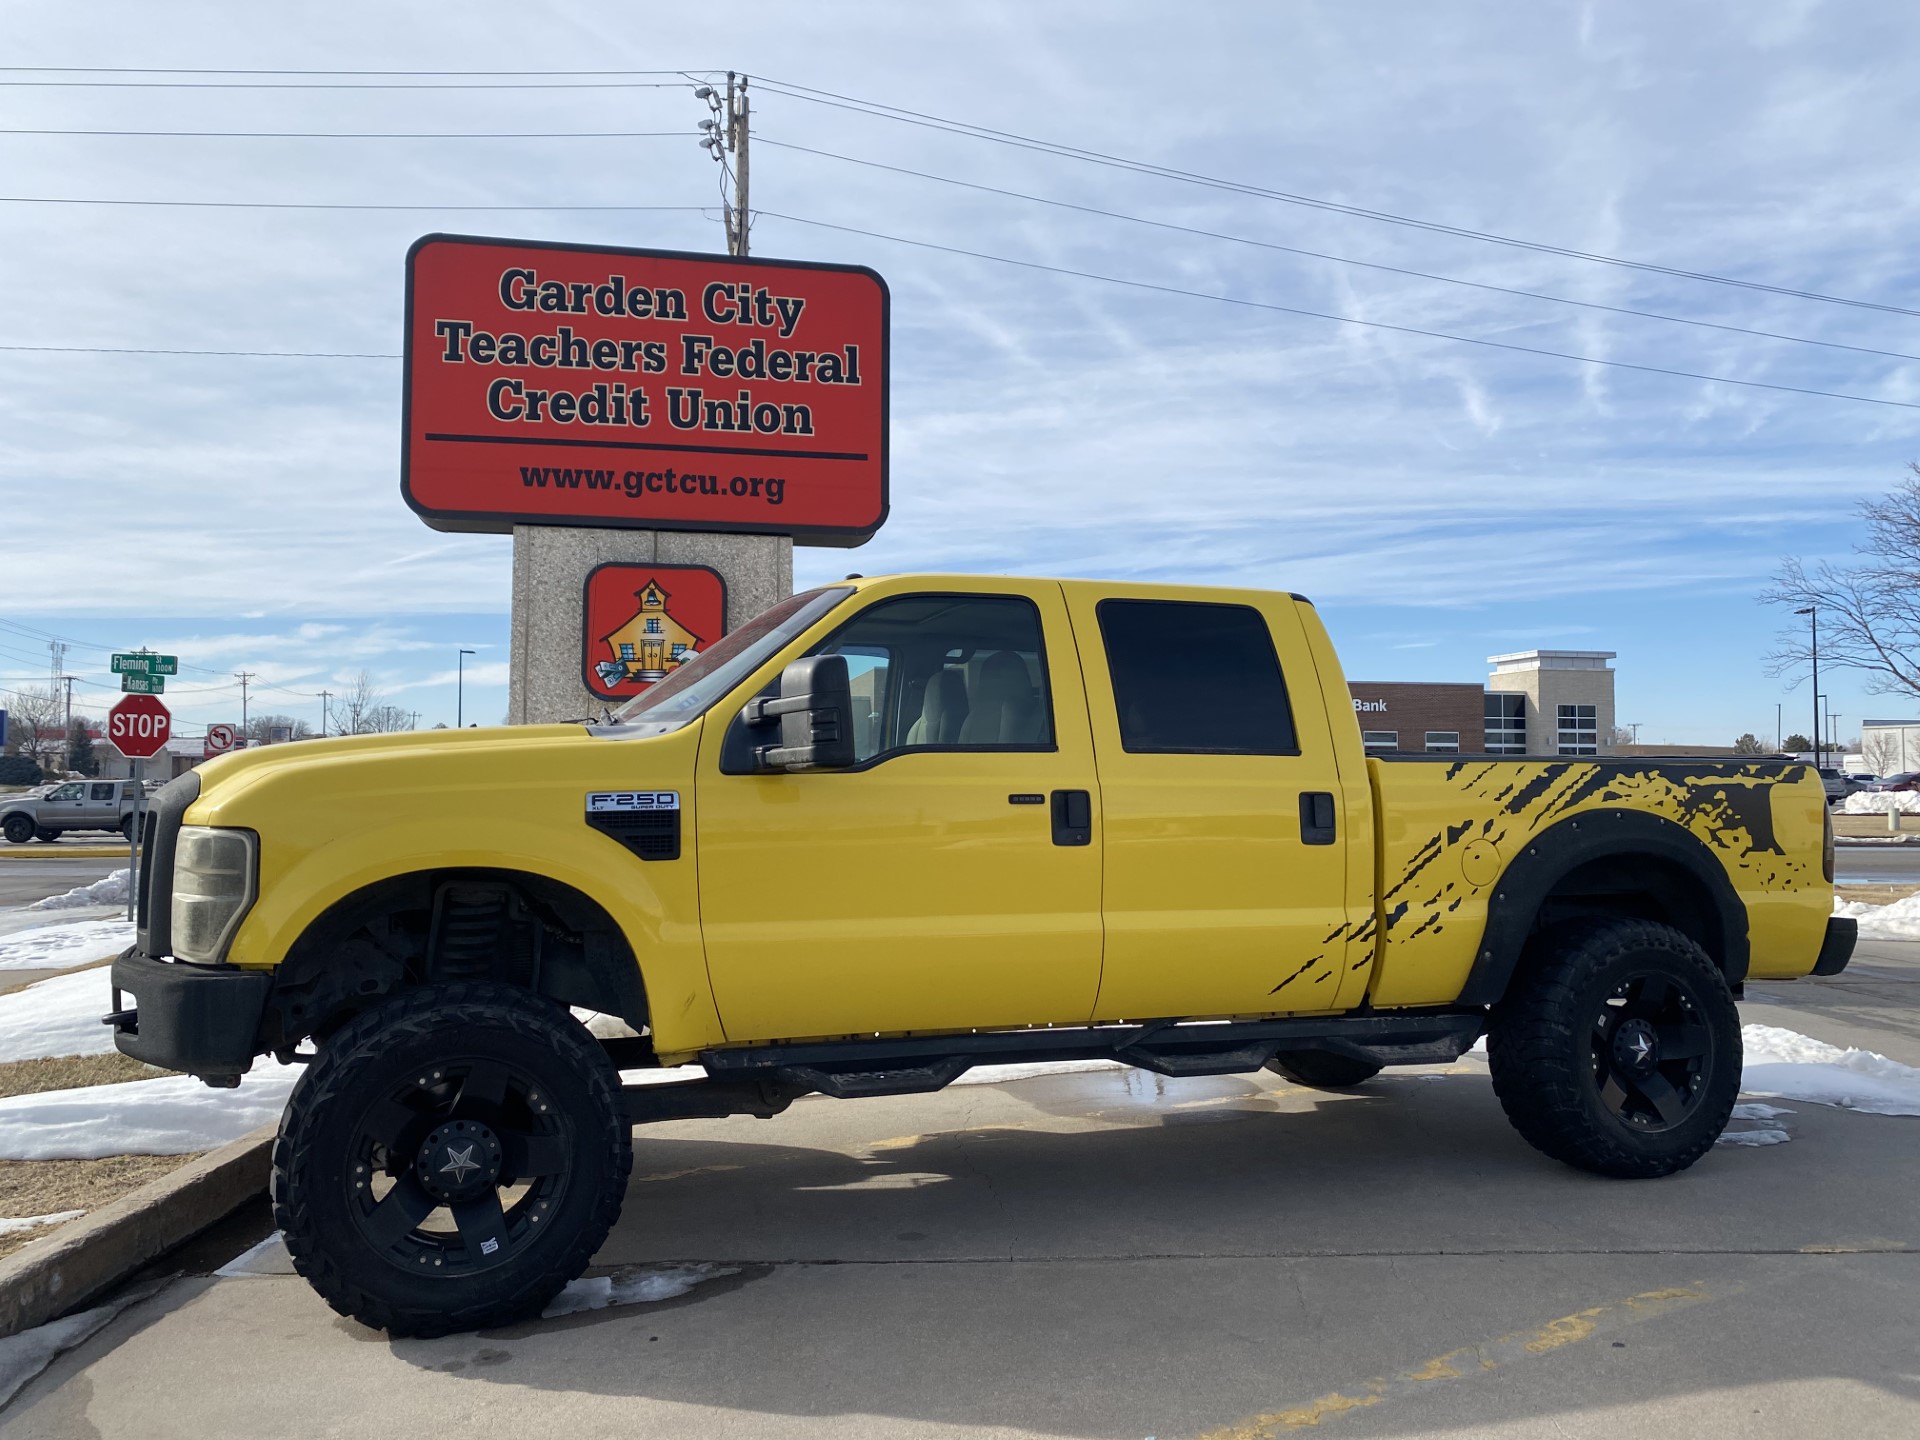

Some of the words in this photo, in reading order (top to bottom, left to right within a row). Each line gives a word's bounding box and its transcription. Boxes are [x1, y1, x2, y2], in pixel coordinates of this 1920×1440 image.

[499, 267, 687, 321] Garden
[703, 282, 805, 338] City
[435, 319, 666, 373] Teachers
[681, 334, 861, 385] Federal
[486, 378, 650, 427] Credit
[667, 387, 814, 436] Union
[520, 466, 786, 504] www.gctcu.org
[113, 656, 149, 674] Fleming
[155, 656, 162, 664] St
[127, 675, 149, 690] Kansas
[1352, 698, 1388, 712] Bank
[112, 713, 167, 738] STOP
[591, 793, 674, 806] F-250
